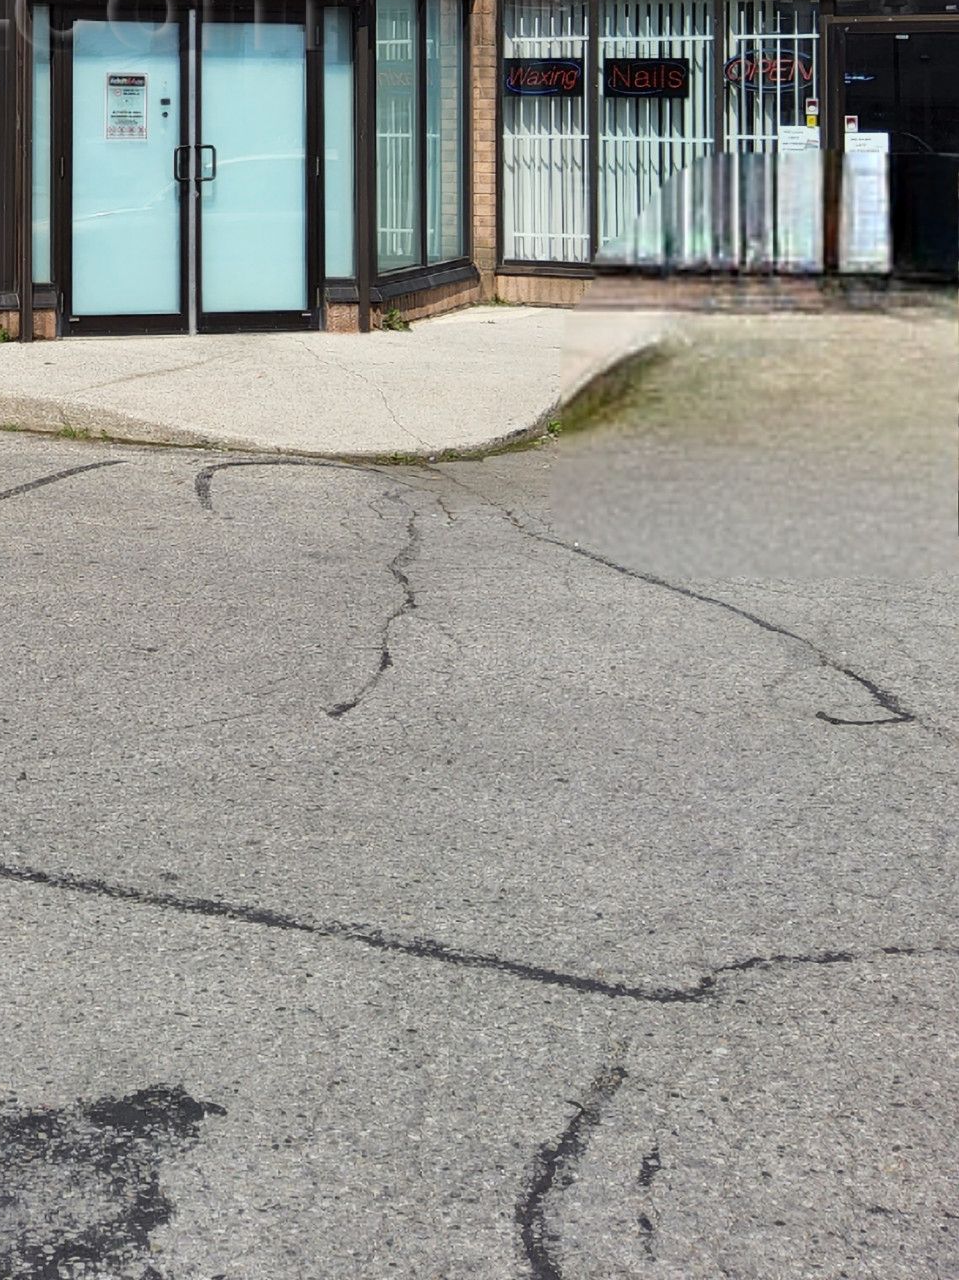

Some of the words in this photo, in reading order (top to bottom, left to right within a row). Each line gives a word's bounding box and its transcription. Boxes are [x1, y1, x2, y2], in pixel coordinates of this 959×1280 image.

[510, 65, 578, 89] Waxing
[613, 65, 683, 88] Nails
[727, 58, 813, 82] OPEN
